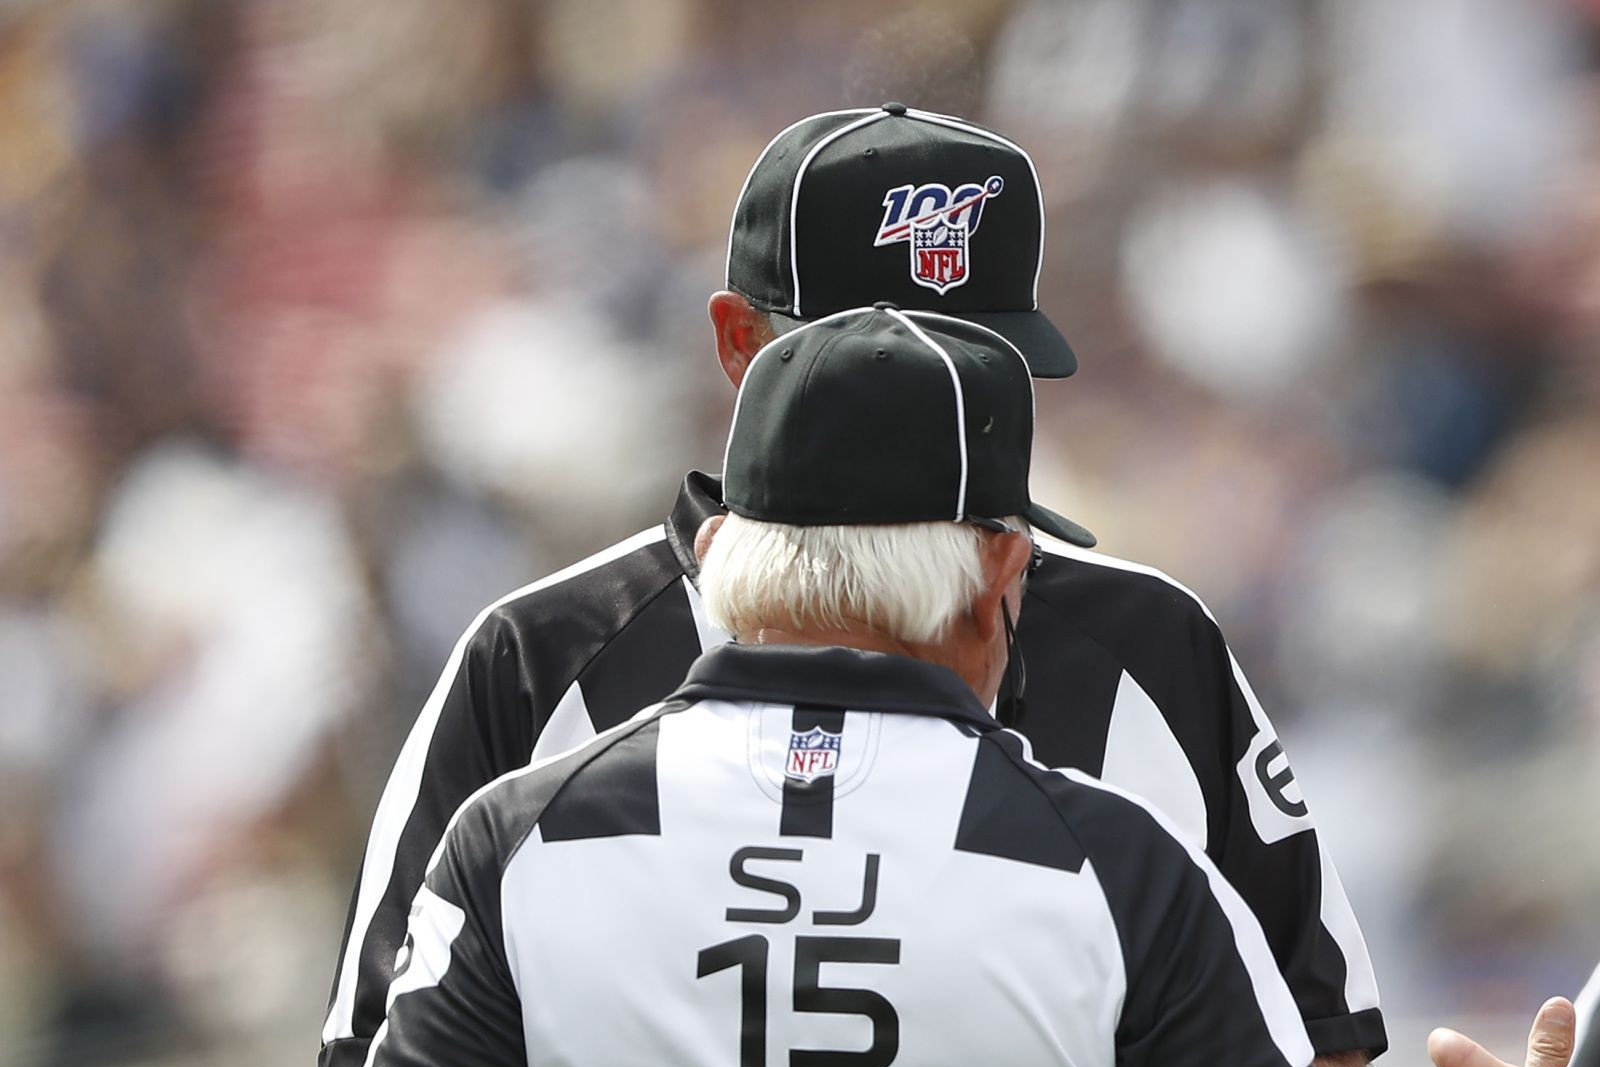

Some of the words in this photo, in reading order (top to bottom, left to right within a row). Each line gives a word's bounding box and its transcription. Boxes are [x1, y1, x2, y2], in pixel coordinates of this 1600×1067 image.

[880, 182, 990, 240] 100
[917, 249, 966, 284] NFL
[790, 750, 834, 774] NFL
[725, 845, 881, 926] SJ
